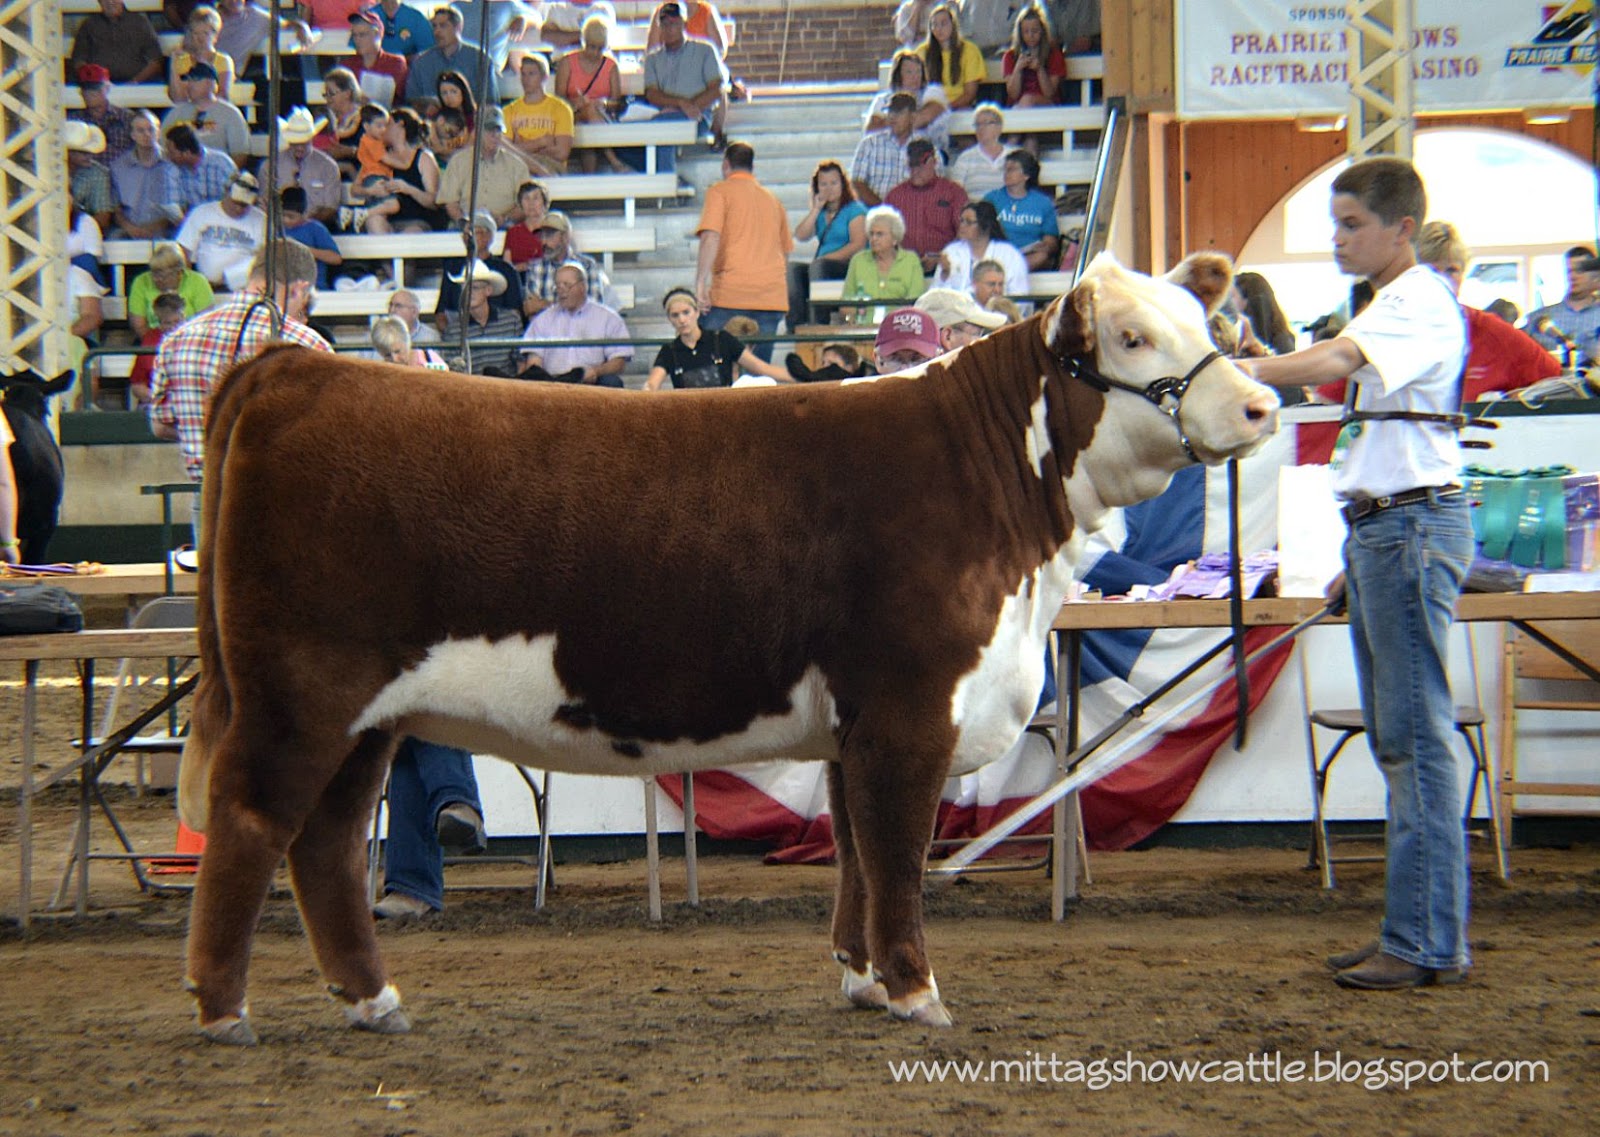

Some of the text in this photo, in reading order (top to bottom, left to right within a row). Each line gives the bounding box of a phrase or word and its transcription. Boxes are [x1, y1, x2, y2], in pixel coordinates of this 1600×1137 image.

[1230, 31, 1332, 54] PRAIRIE
[1508, 47, 1565, 65] PRAIRIE
[996, 208, 1042, 226] Angus
